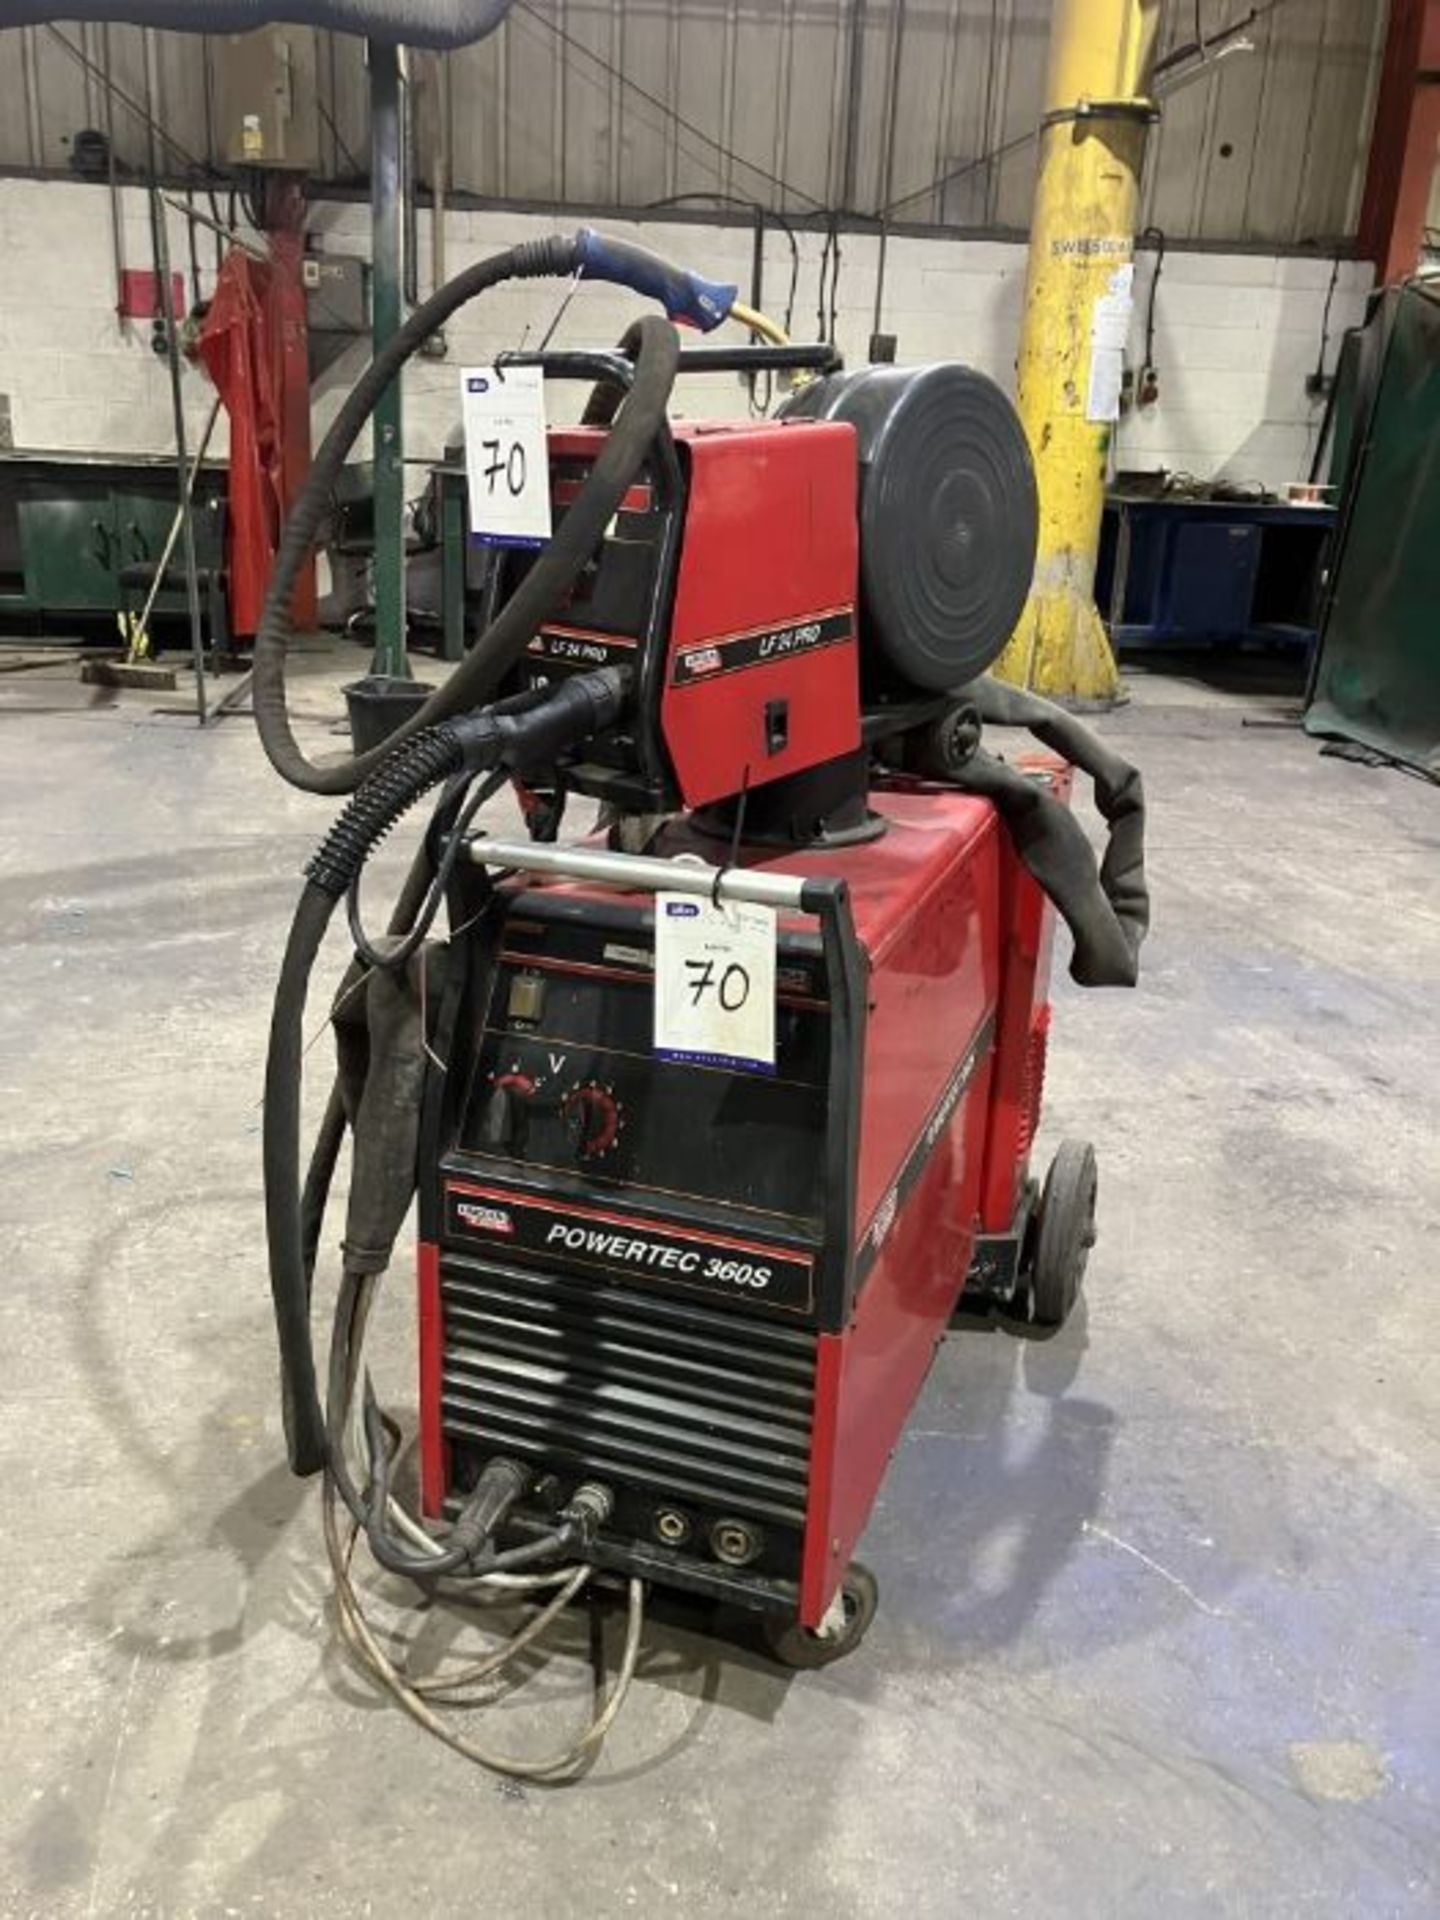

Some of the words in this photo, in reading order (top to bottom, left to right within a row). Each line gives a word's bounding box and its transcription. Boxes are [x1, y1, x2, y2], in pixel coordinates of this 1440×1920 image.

[482, 439, 527, 497] 70
[581, 646, 608, 662] PRO
[793, 624, 821, 646] PRO
[685, 959, 750, 1012] 70
[548, 1052, 566, 1075] V
[547, 1223, 700, 1273] POWERTEC
[703, 1257, 772, 1289] 360S
